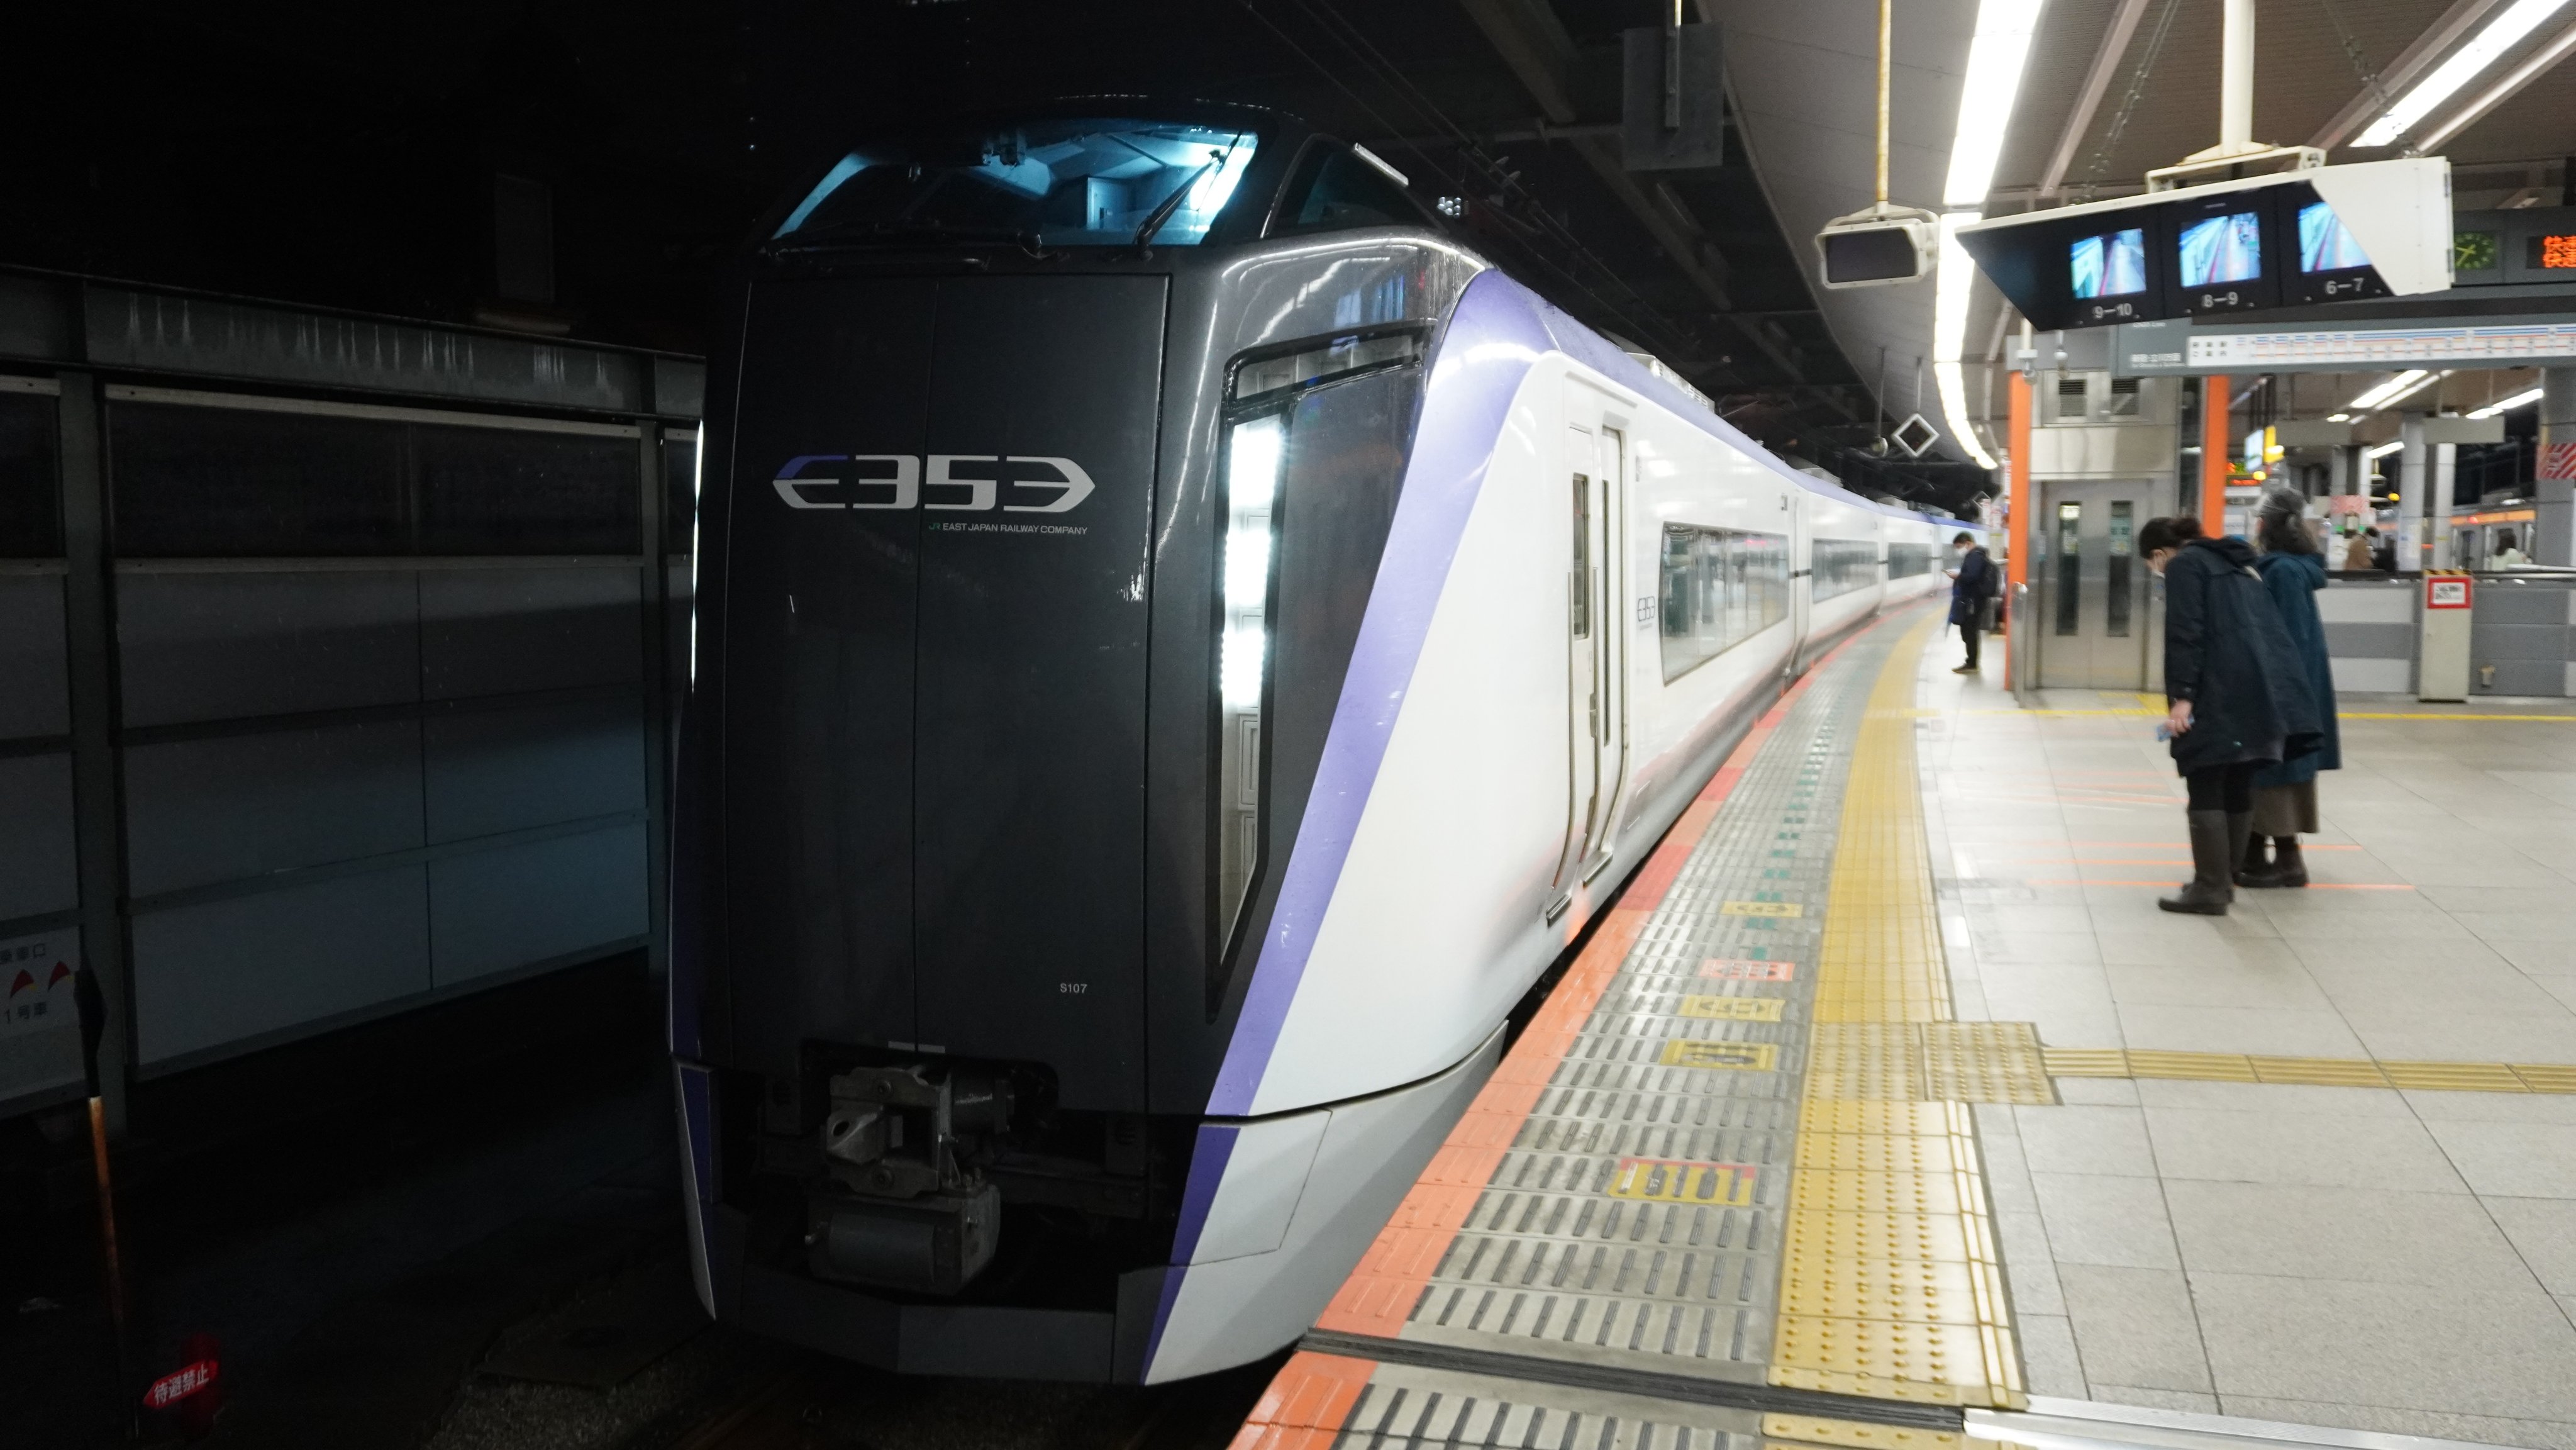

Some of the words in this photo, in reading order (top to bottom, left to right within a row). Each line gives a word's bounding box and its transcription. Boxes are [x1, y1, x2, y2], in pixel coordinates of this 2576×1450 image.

[772, 454, 1096, 513] E353
[943, 523, 967, 531] EAST
[968, 523, 998, 532] JAPAN
[1000, 525, 1039, 533] RAILWAY
[1040, 525, 1088, 535] COMPANY
[1060, 983, 1087, 994] S107
